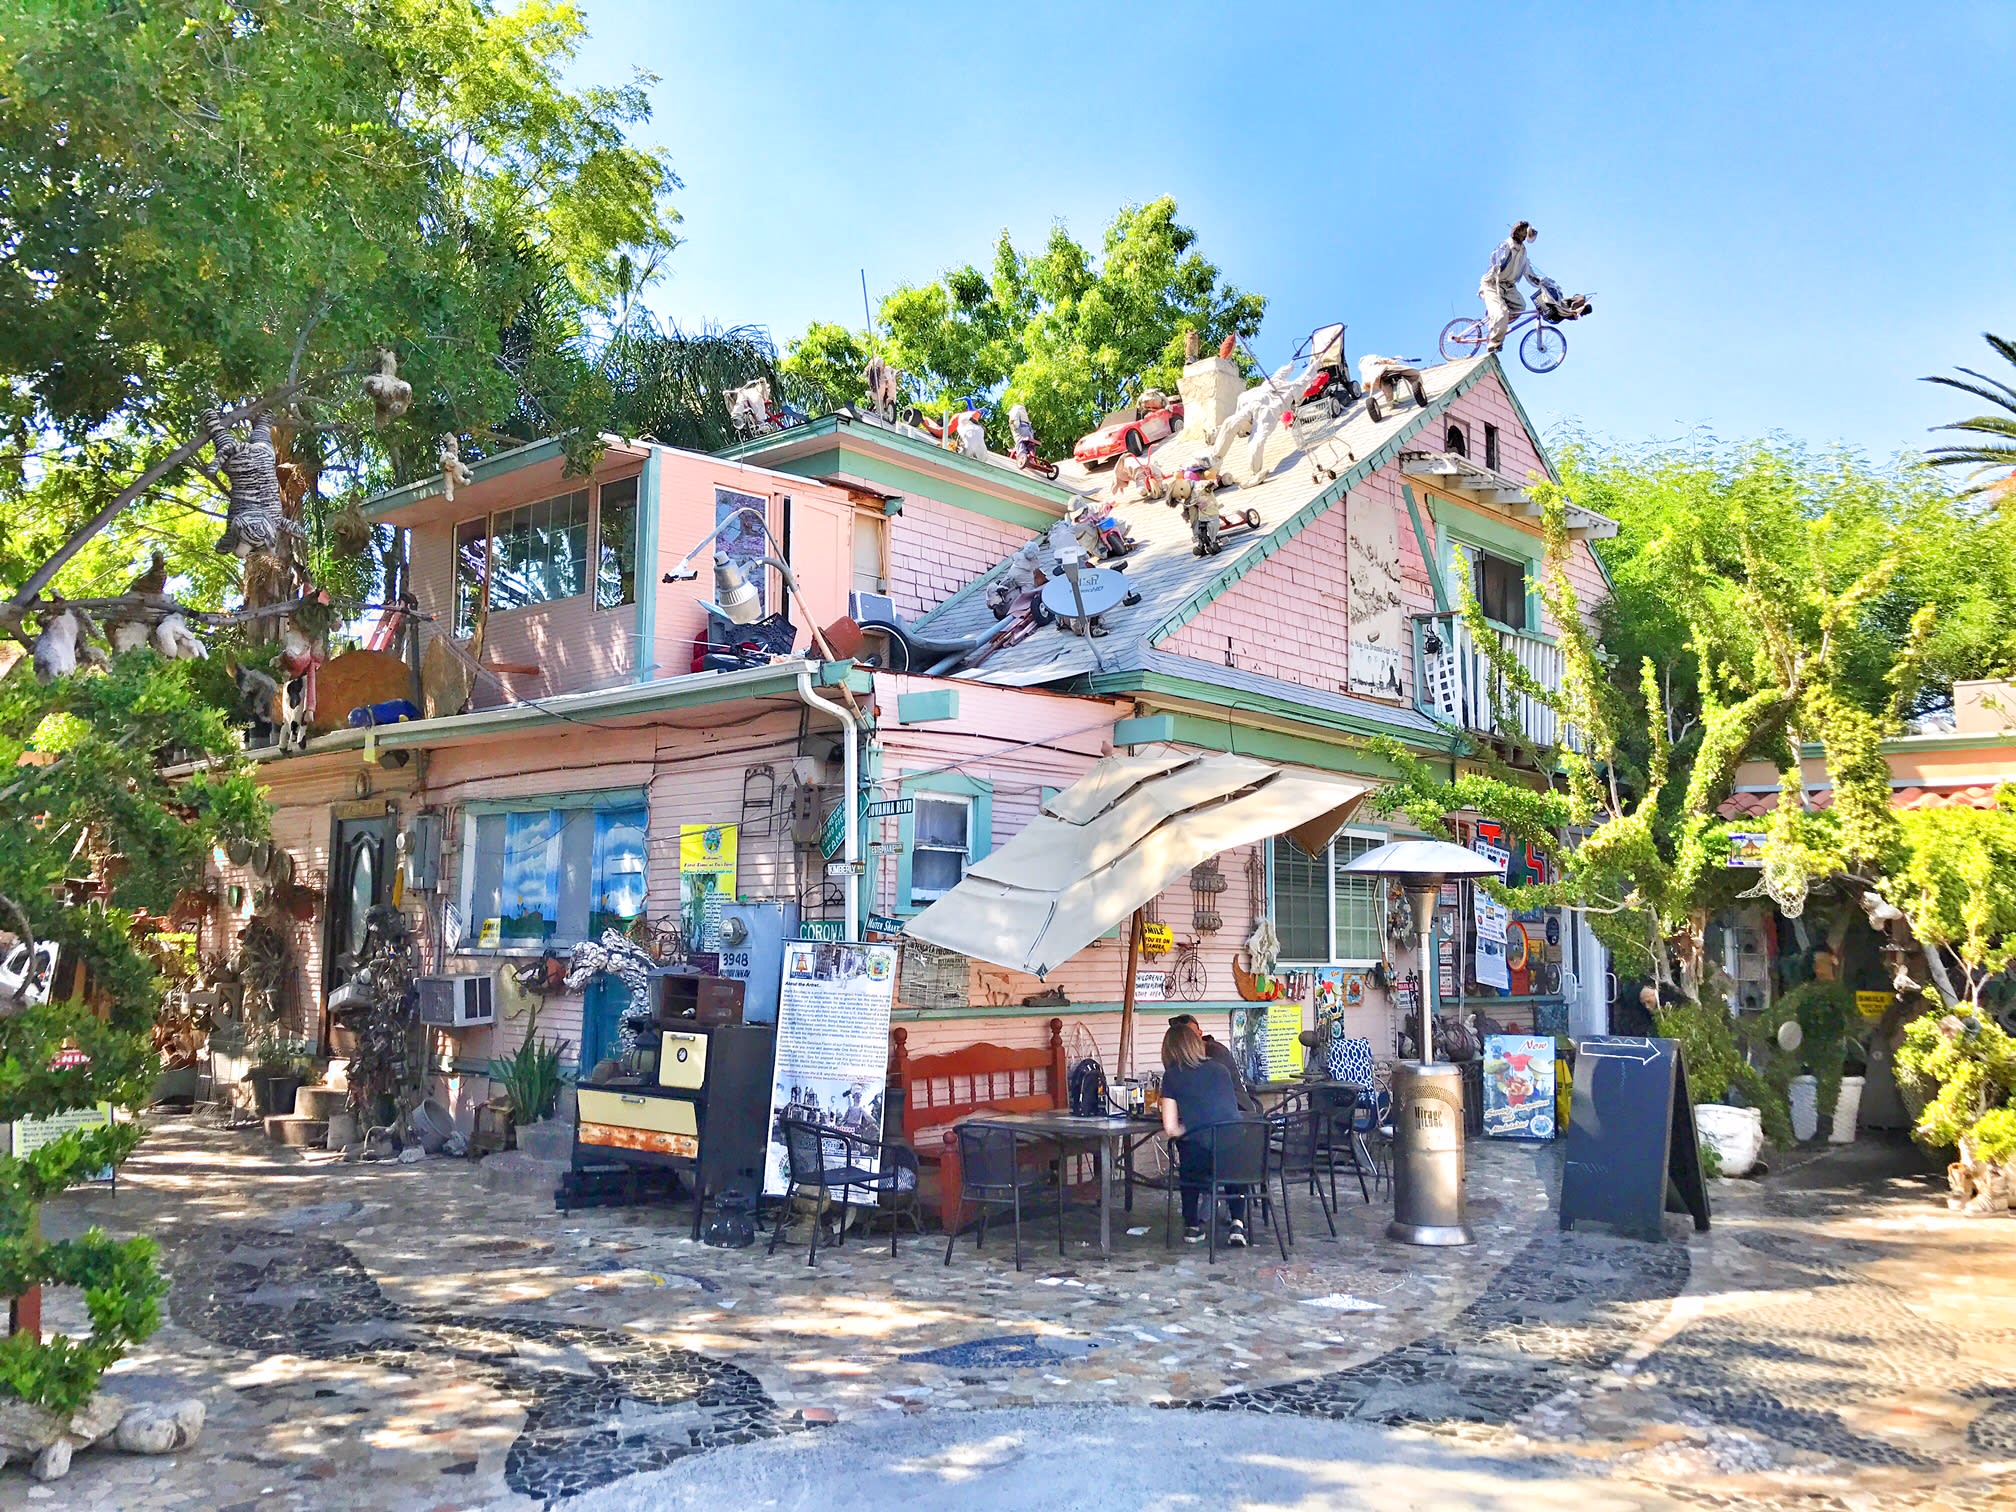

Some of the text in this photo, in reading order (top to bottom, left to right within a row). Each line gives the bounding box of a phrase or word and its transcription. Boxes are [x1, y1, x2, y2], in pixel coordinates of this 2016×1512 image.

[896, 799, 913, 814] BLVD
[829, 864, 855, 874] KIMBERLY
[800, 924, 845, 941] CORONA
[723, 953, 749, 967] 3948
[1415, 1106, 1442, 1121] Mirage
